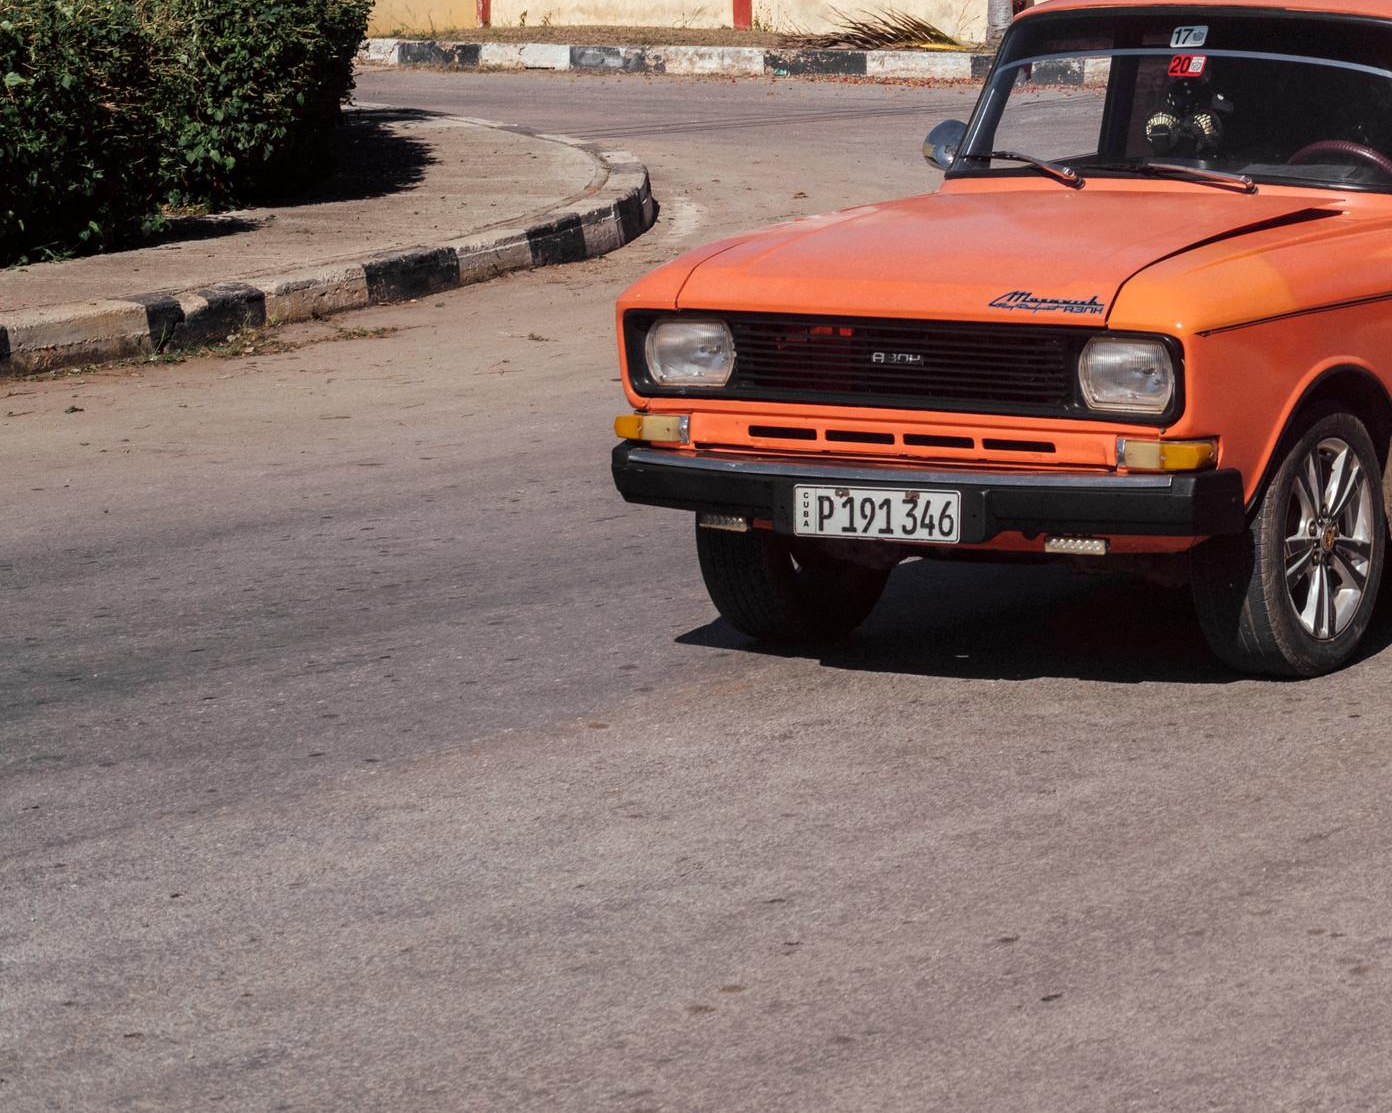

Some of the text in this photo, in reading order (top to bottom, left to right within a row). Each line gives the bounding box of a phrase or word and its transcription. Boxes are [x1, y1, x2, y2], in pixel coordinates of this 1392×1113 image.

[1175, 28, 1194, 45] 17
[1169, 56, 1191, 73] 20
[802, 492, 810, 528] CUBA
